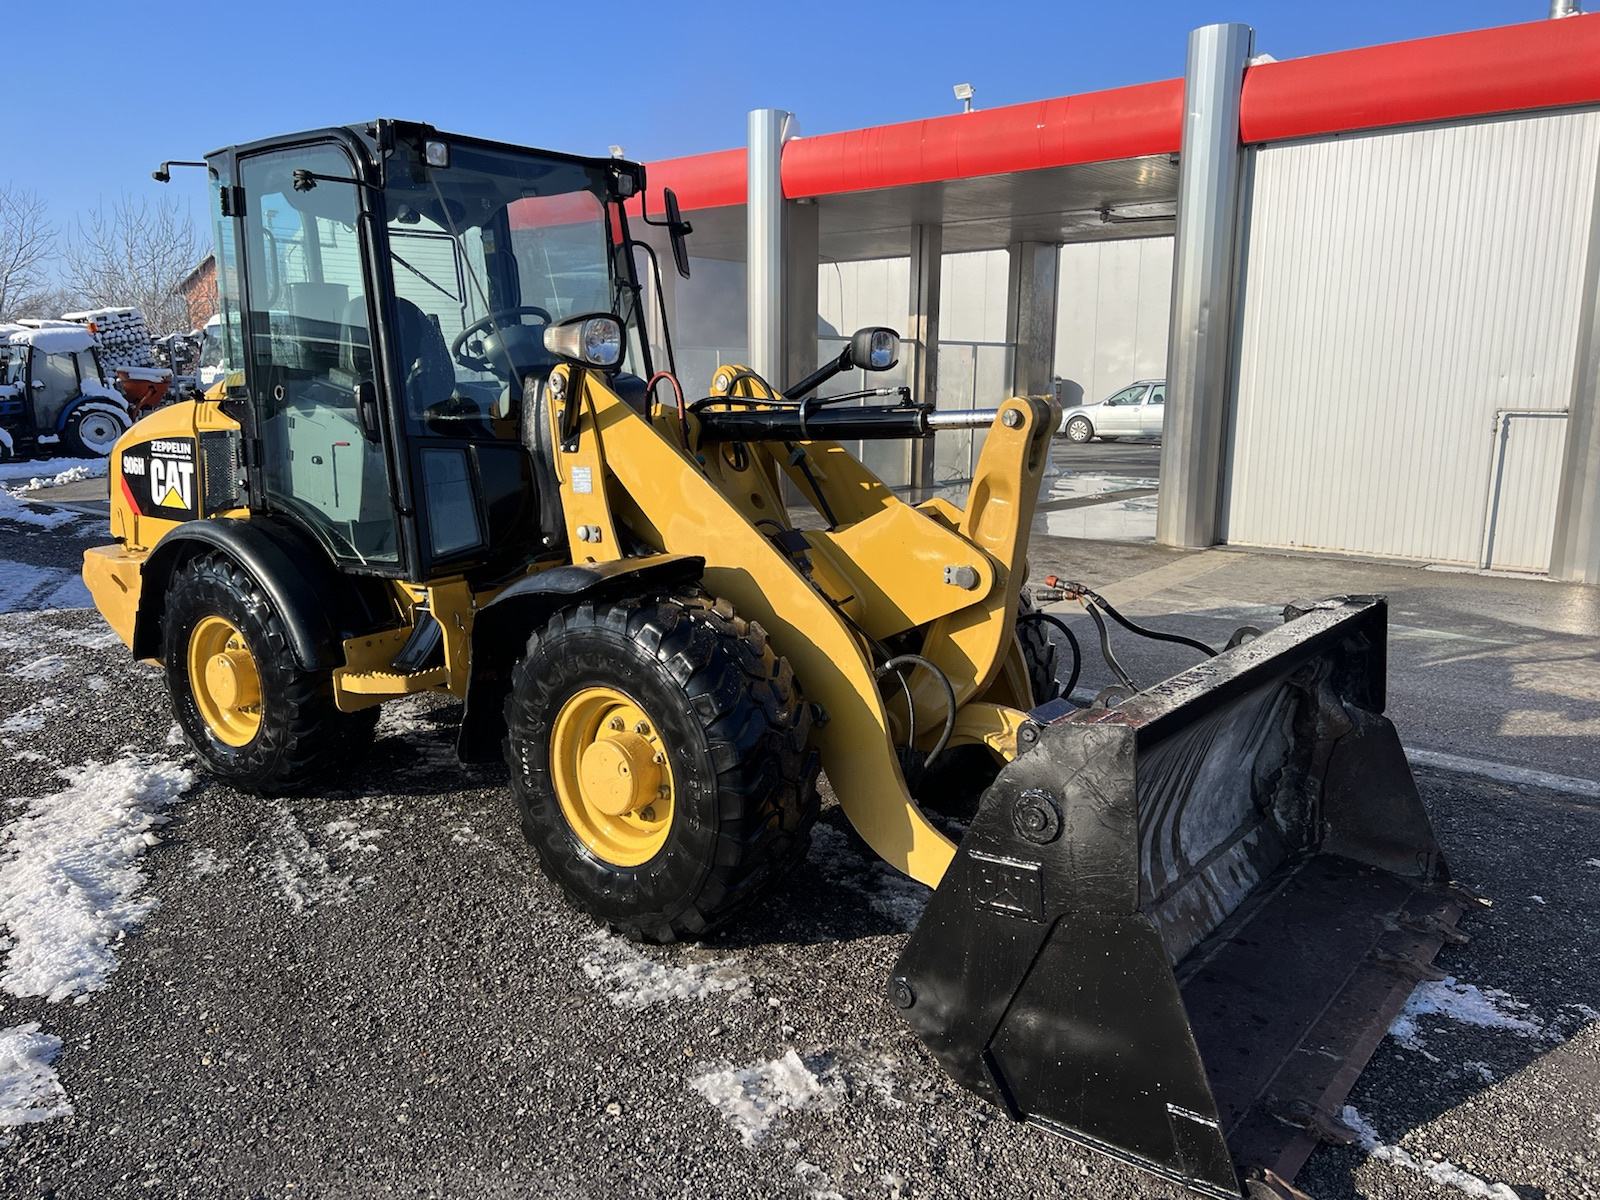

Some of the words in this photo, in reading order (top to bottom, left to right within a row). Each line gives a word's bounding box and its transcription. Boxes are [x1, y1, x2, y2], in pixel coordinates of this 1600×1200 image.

[151, 441, 191, 454] ZEPPELIN
[123, 456, 145, 475] 906H
[150, 458, 194, 510] CAT
